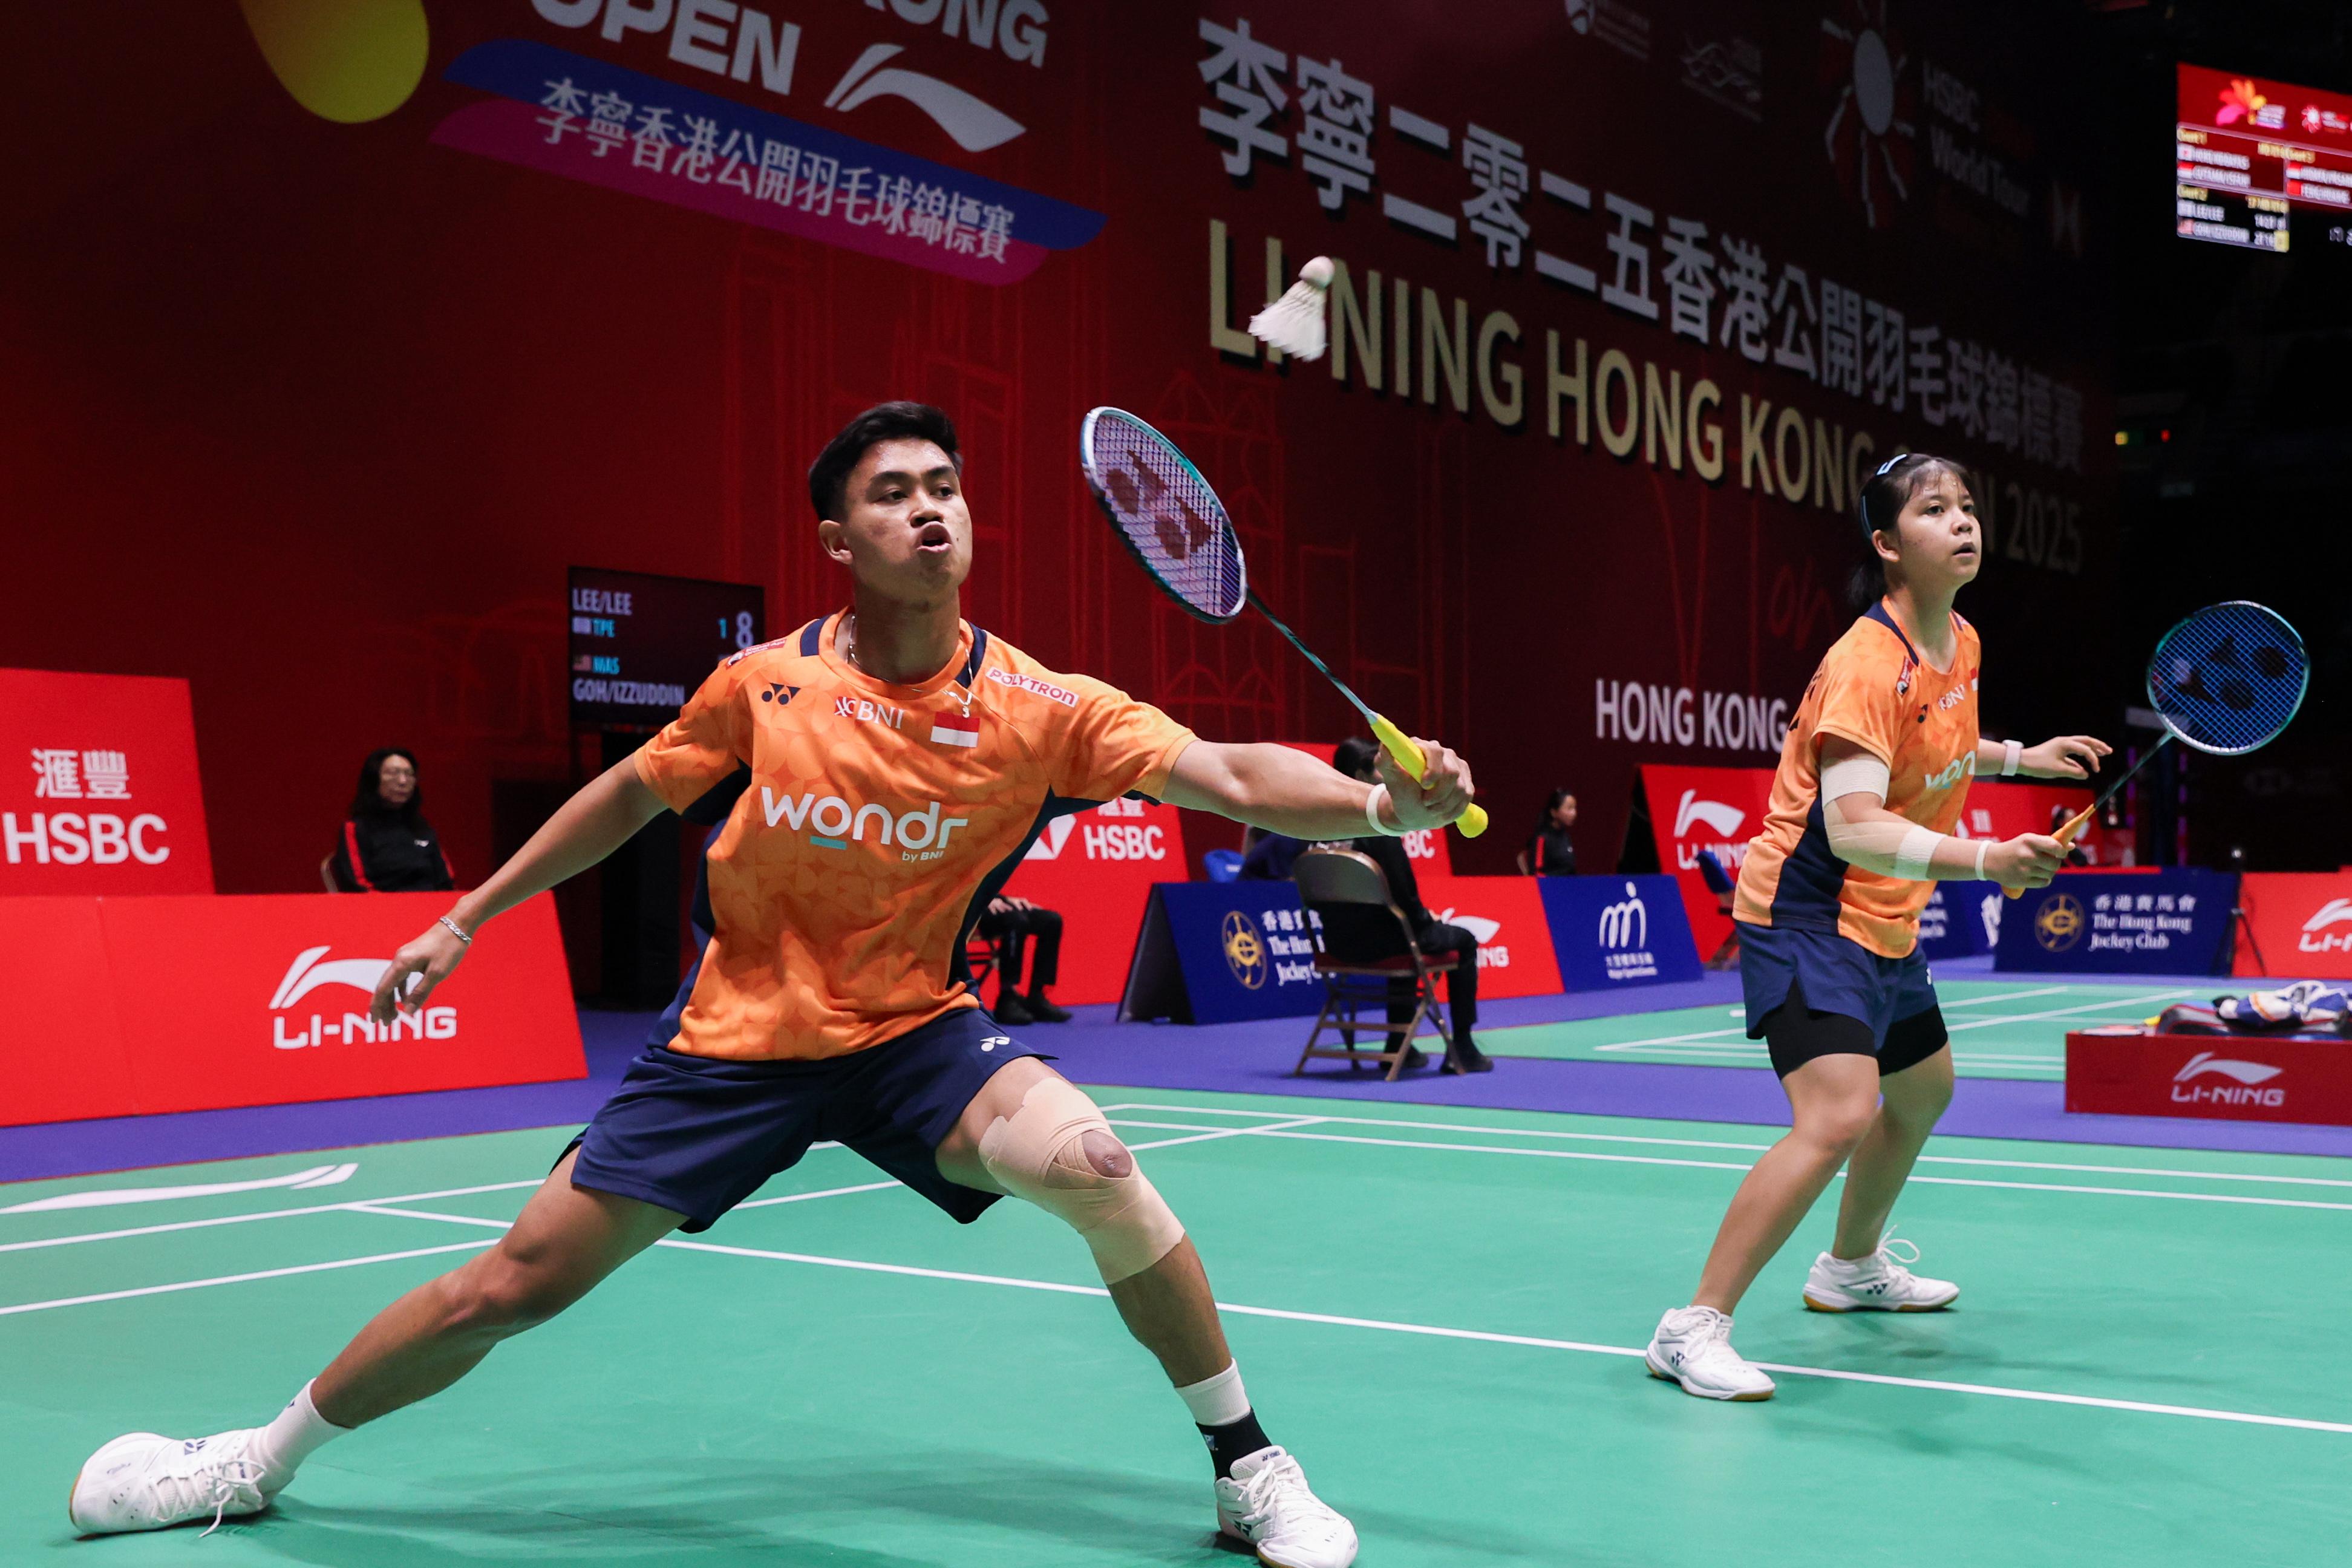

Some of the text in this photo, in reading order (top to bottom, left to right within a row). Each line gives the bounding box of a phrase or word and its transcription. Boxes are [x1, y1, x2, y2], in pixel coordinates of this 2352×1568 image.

[863, 0, 1050, 69] NG
[536, 78, 1014, 264] 李寧香港公開羽毛球錦標賽
[1198, 17, 2083, 475] 李寧二零二五香港公開羽毛球錦標賽
[1210, 218, 1524, 427] LINING
[1546, 328, 1723, 482] HONG
[2005, 482, 2085, 577] 2025
[572, 588, 633, 616] LEE/LEE
[593, 610, 754, 649] TPE 1 8
[573, 677, 685, 707] GOH/IZZUDDIN
[857, 700, 906, 730] BNI
[1596, 678, 1789, 753] HONG KONG
[762, 786, 967, 850] wondr
[2, 812, 171, 865] HSBC
[1083, 824, 1166, 860] HSBC
[902, 851, 944, 863] by BNI
[2092, 913, 2192, 935] The Hong Kong
[1267, 935, 1291, 956] The
[2088, 932, 2170, 953] Jockey Club
[1275, 960, 1312, 987] Jockey
[273, 1005, 460, 1050] LI-NING
[2171, 1085, 2285, 1107] LI-NING
